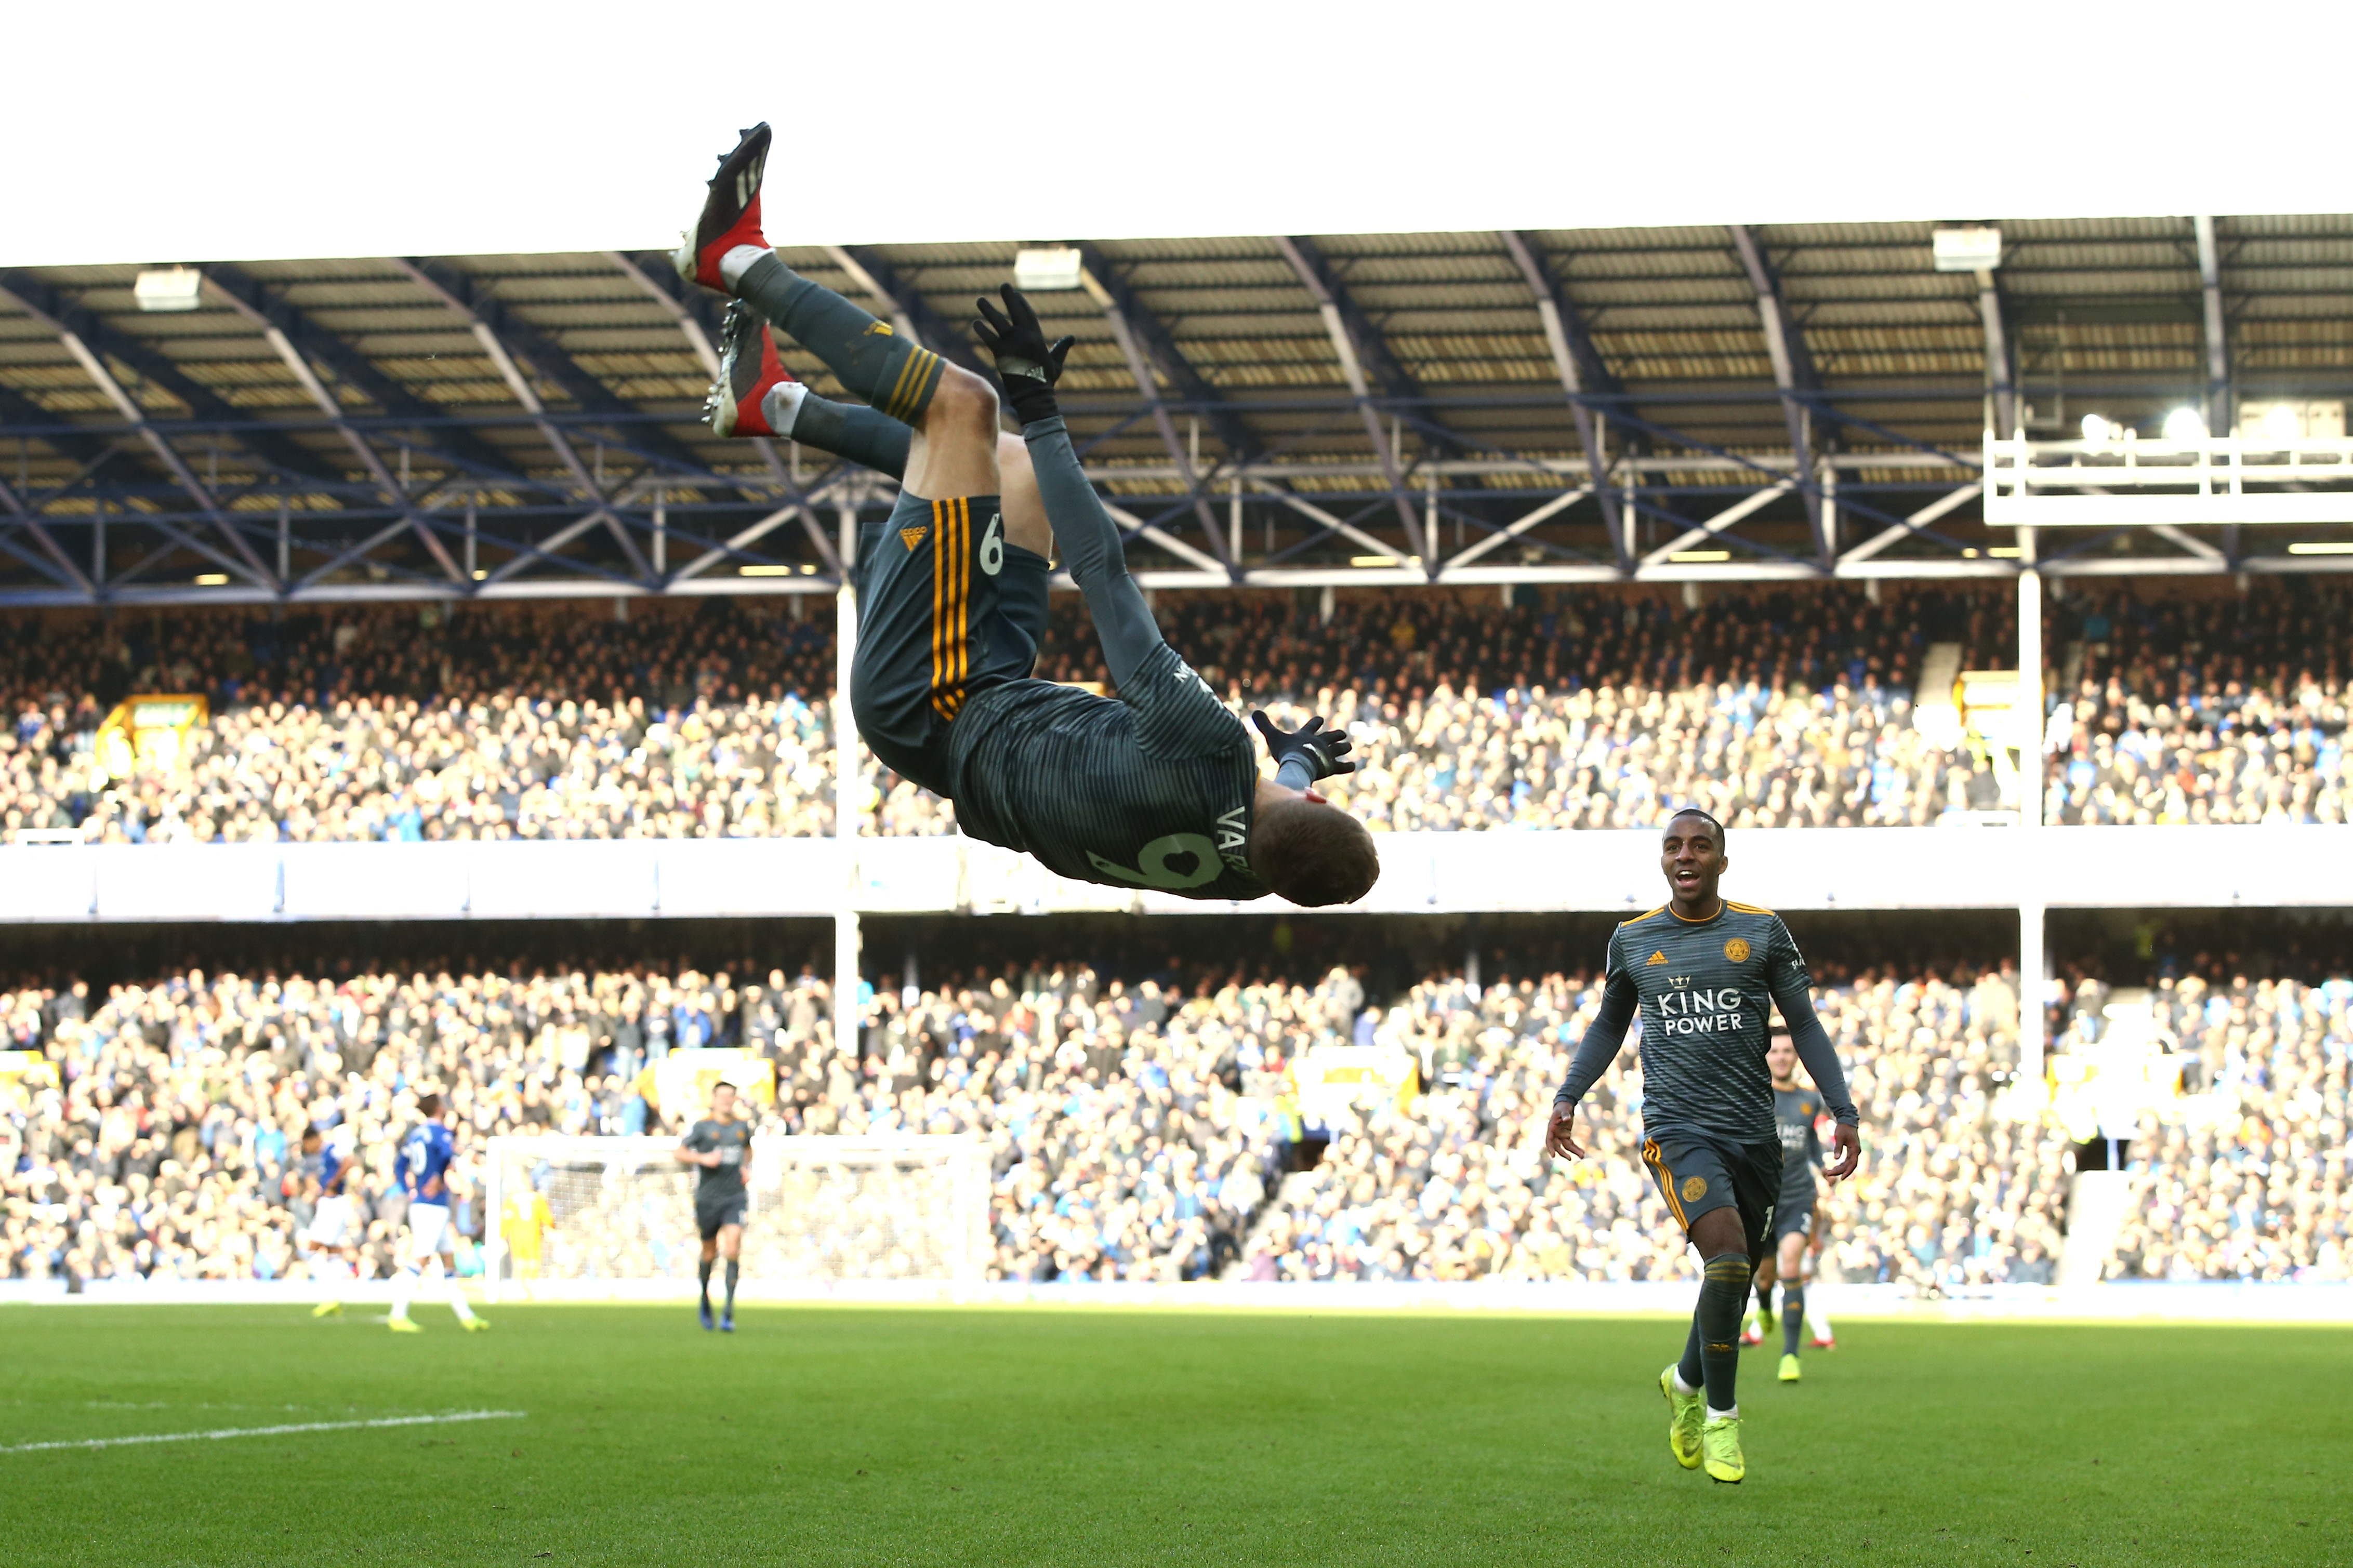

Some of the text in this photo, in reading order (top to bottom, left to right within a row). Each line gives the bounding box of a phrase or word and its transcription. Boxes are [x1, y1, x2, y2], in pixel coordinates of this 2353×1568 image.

[1086, 832, 1224, 889] 9
[1657, 988, 1741, 1016] KING
[1664, 1013, 1743, 1036] POWER
